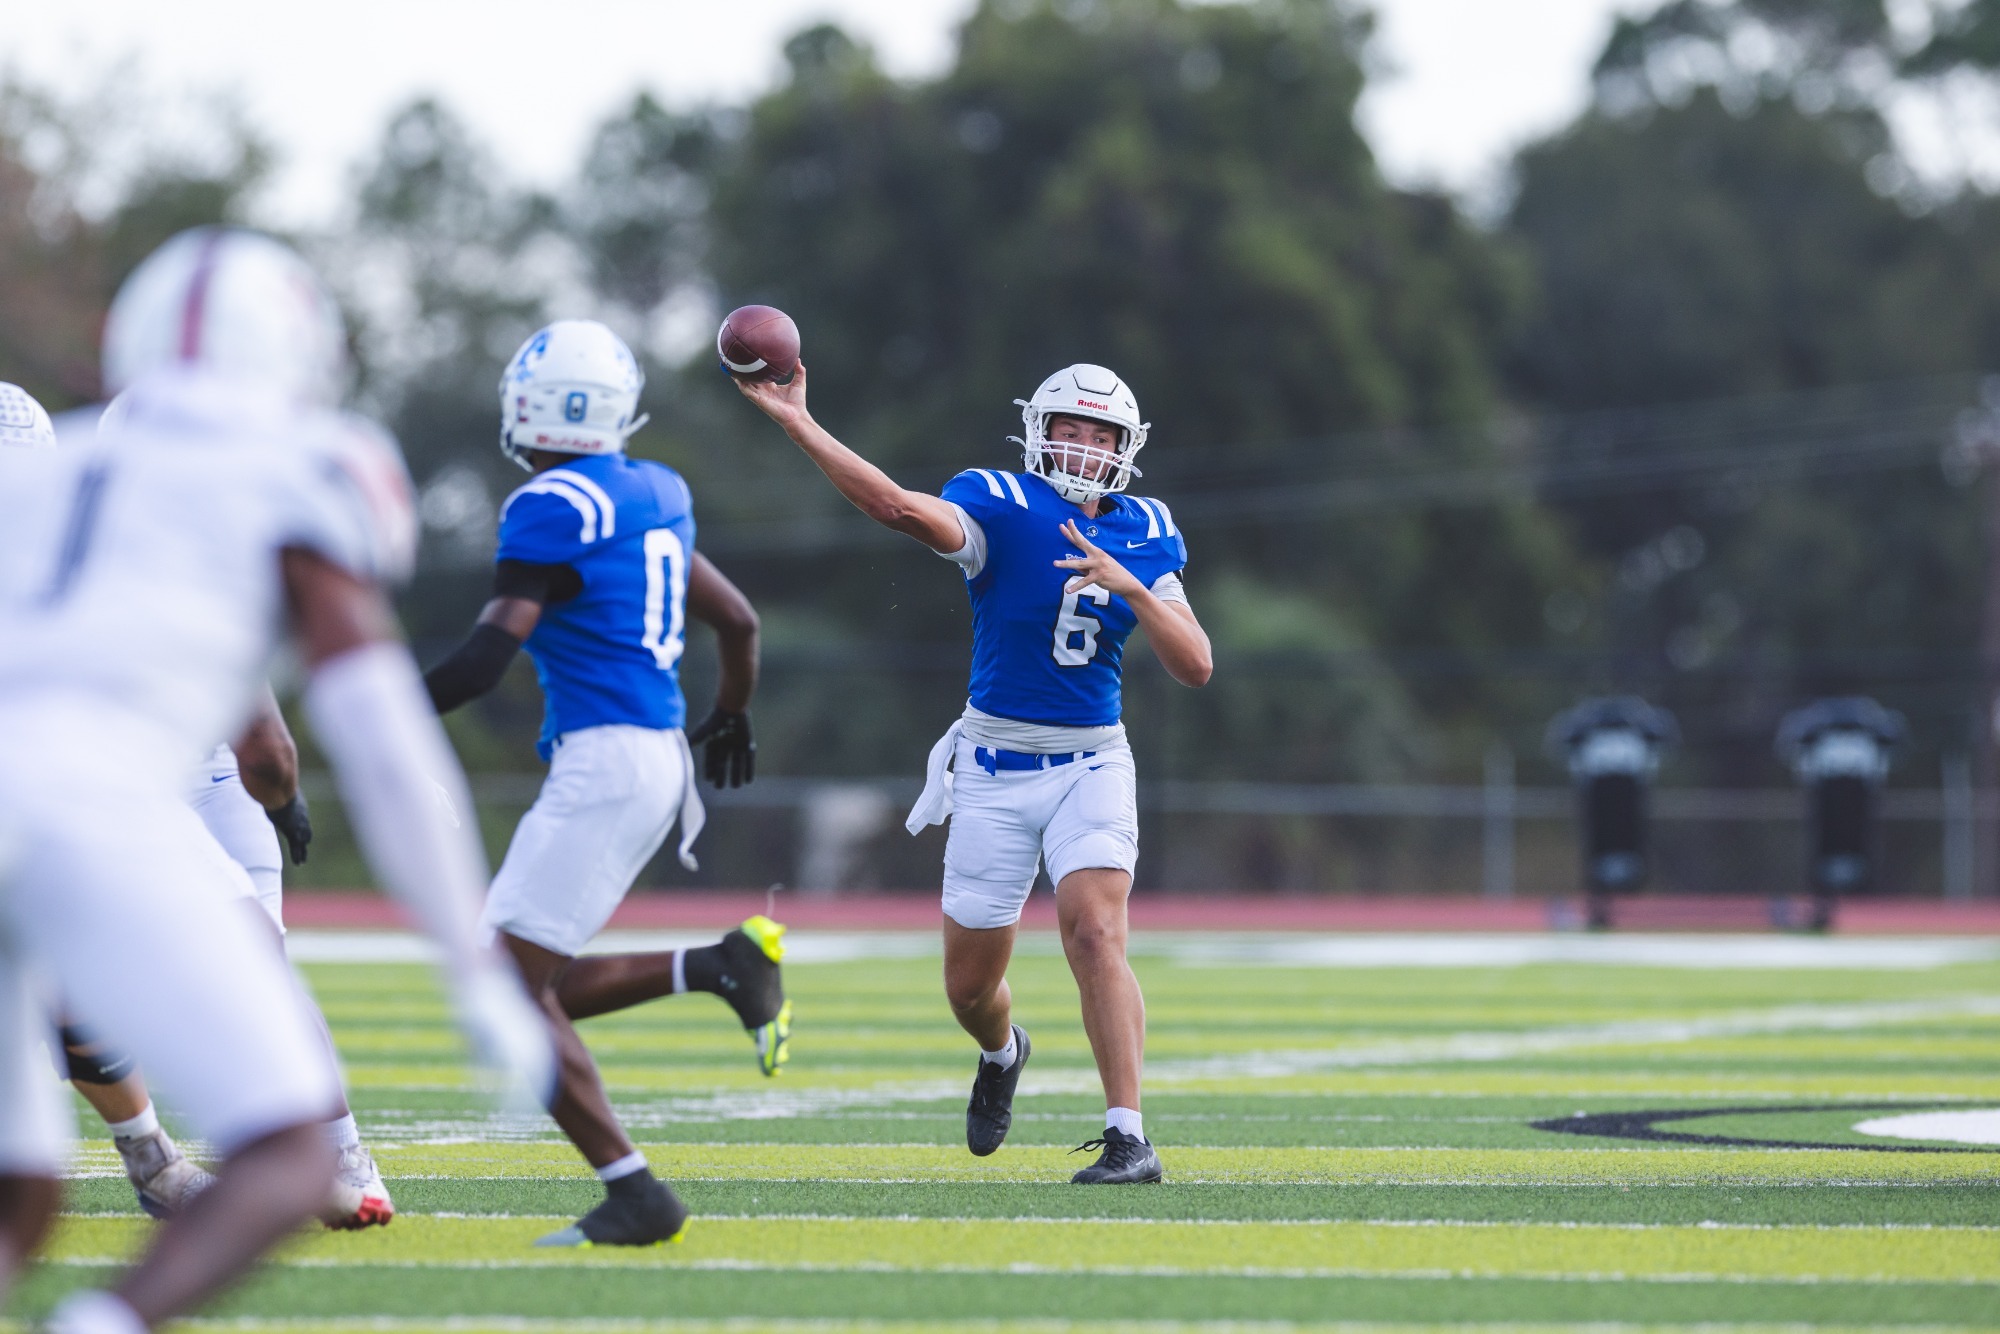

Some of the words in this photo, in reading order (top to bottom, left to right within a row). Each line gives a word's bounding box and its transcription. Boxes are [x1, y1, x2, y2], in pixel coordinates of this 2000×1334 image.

[565, 392, 589, 424] 0
[1077, 399, 1109, 412] Riddell
[641, 527, 686, 671] 0
[1052, 574, 1111, 667] 6
